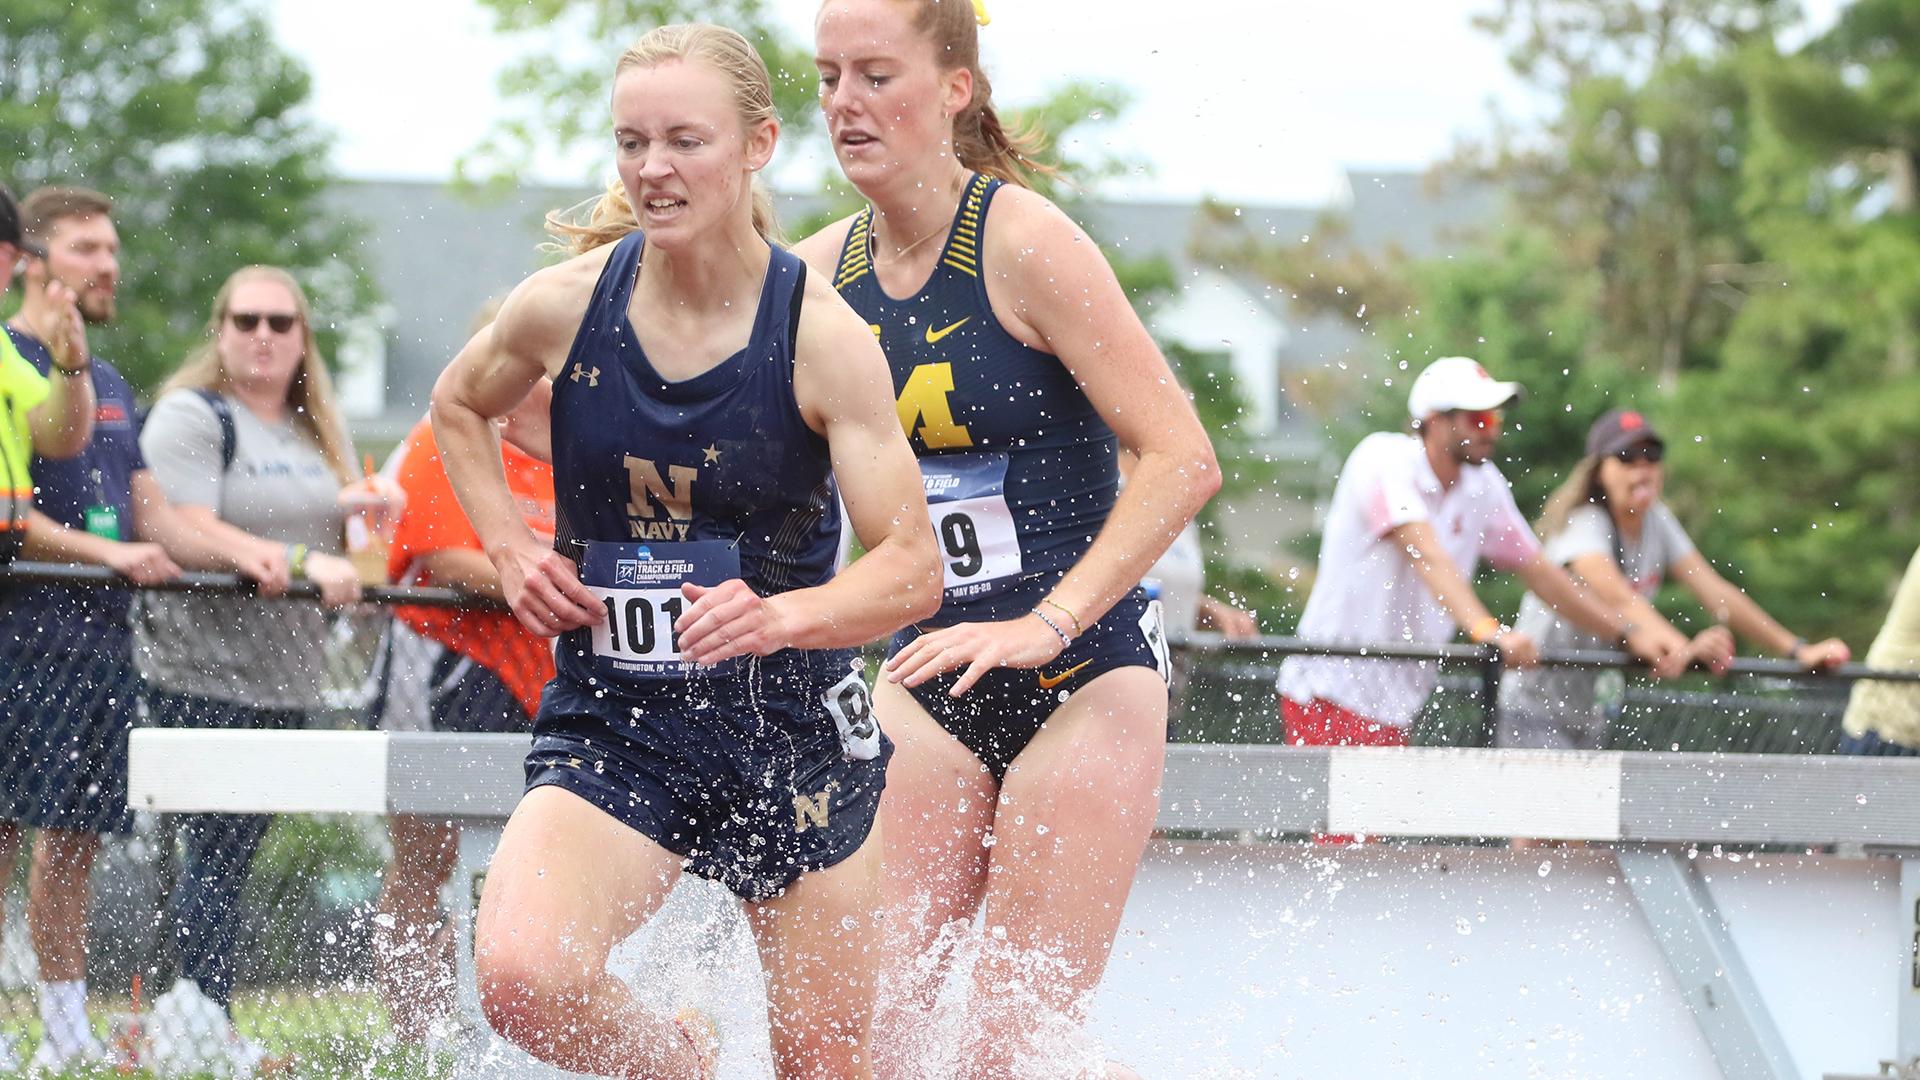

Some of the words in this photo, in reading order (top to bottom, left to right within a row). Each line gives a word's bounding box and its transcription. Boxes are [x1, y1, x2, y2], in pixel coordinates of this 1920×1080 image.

[623, 455, 698, 520] N
[934, 477, 960, 488] FIELD
[629, 520, 690, 542] NAVY
[637, 564, 663, 574] TRACK
[664, 564, 671, 574] &
[671, 563, 694, 573] FIELD
[953, 586, 968, 598] MAY
[969, 581, 992, 595] 25-28
[612, 660, 655, 672] BLOOMINGTON,
[677, 662, 694, 671] MAY
[792, 792, 831, 834] N
